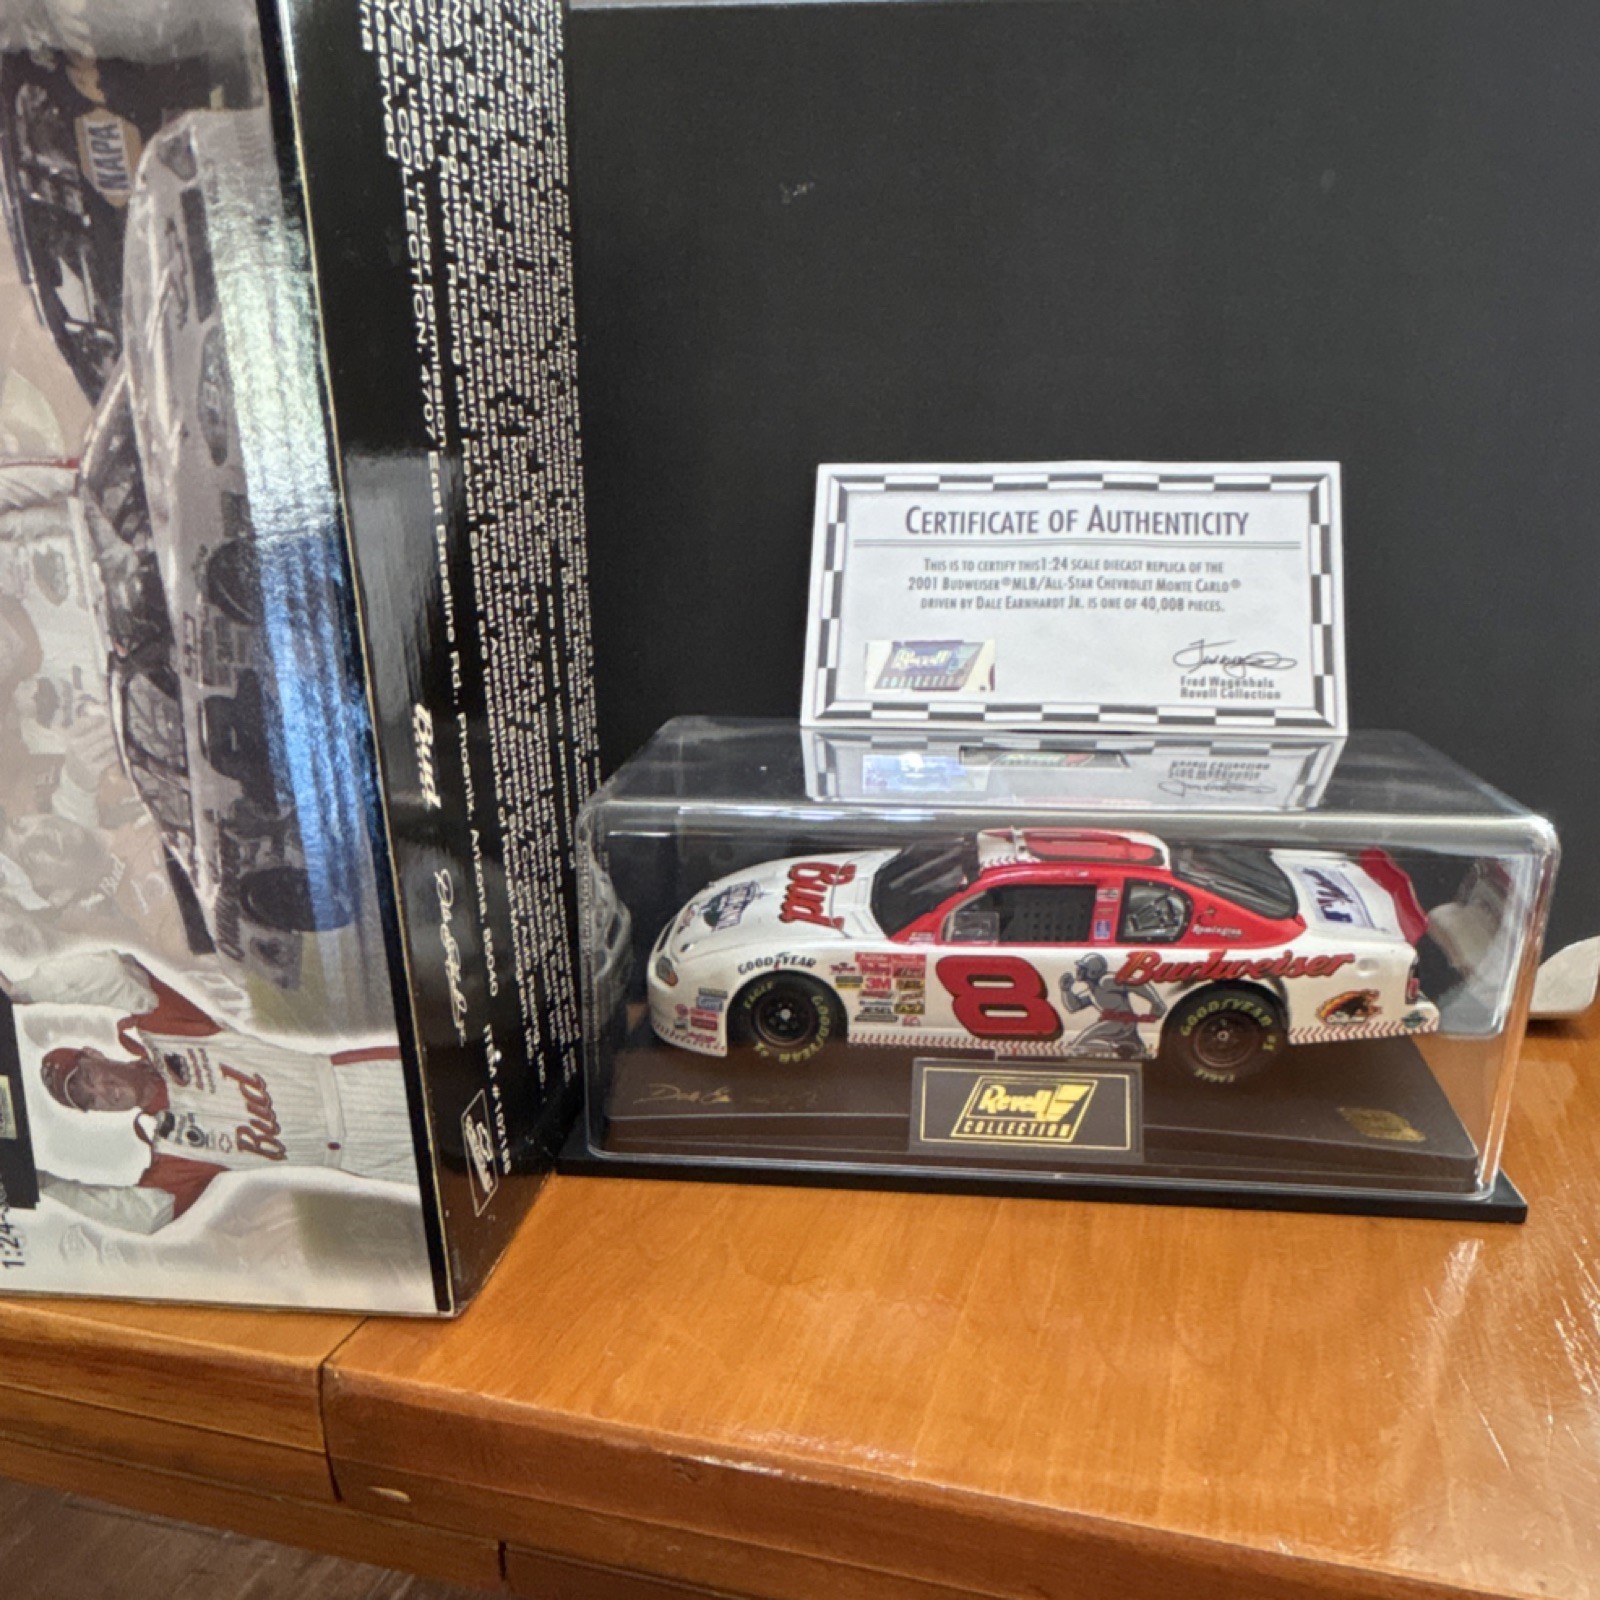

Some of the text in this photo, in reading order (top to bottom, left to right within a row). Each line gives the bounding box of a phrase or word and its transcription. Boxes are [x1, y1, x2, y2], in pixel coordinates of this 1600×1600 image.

[414, 0, 424, 32] er
[451, 0, 461, 47] NA
[373, 0, 396, 157] eserved
[87, 121, 131, 191] NAPA
[399, 0, 414, 73] gos
[408, 87, 423, 170] used
[416, 182, 431, 274] under
[387, 0, 497, 998] VELL COLLECTION, 4707 East Baseline Rd., Phoenix, Arizona, 85040
[905, 504, 1249, 535] CERTIFICATE OF AUTHENTICITY
[907, 576, 938, 591] 2001
[737, 952, 817, 976] GOODYEAR
[1114, 950, 1356, 987] Budweiser
[935, 955, 1063, 1042] 8
[220, 1063, 288, 1161] Bud
[977, 1084, 1053, 1122] Revell
[963, 1120, 1071, 1138] COLLECTION
